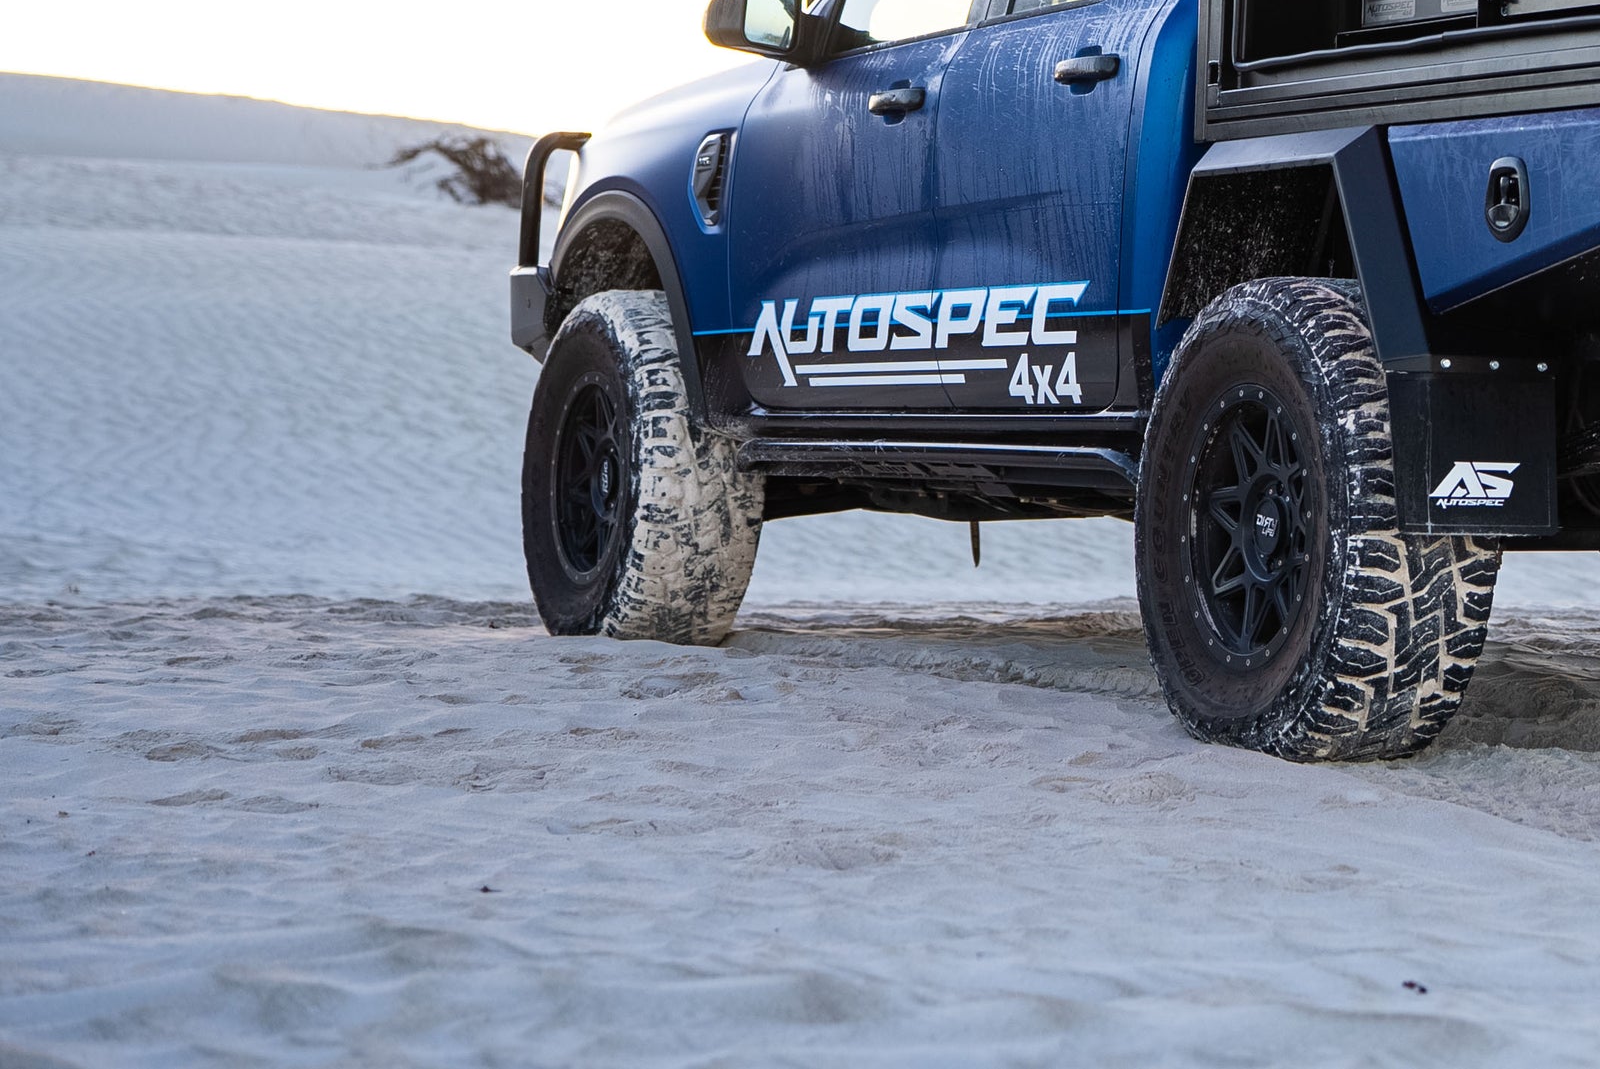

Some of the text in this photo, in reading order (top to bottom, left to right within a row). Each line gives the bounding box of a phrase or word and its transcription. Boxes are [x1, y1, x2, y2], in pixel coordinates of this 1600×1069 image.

[747, 279, 1091, 387] AUTOSPEC
[1428, 461, 1520, 498] AS
[1436, 498, 1504, 509] AUTOSPEC
